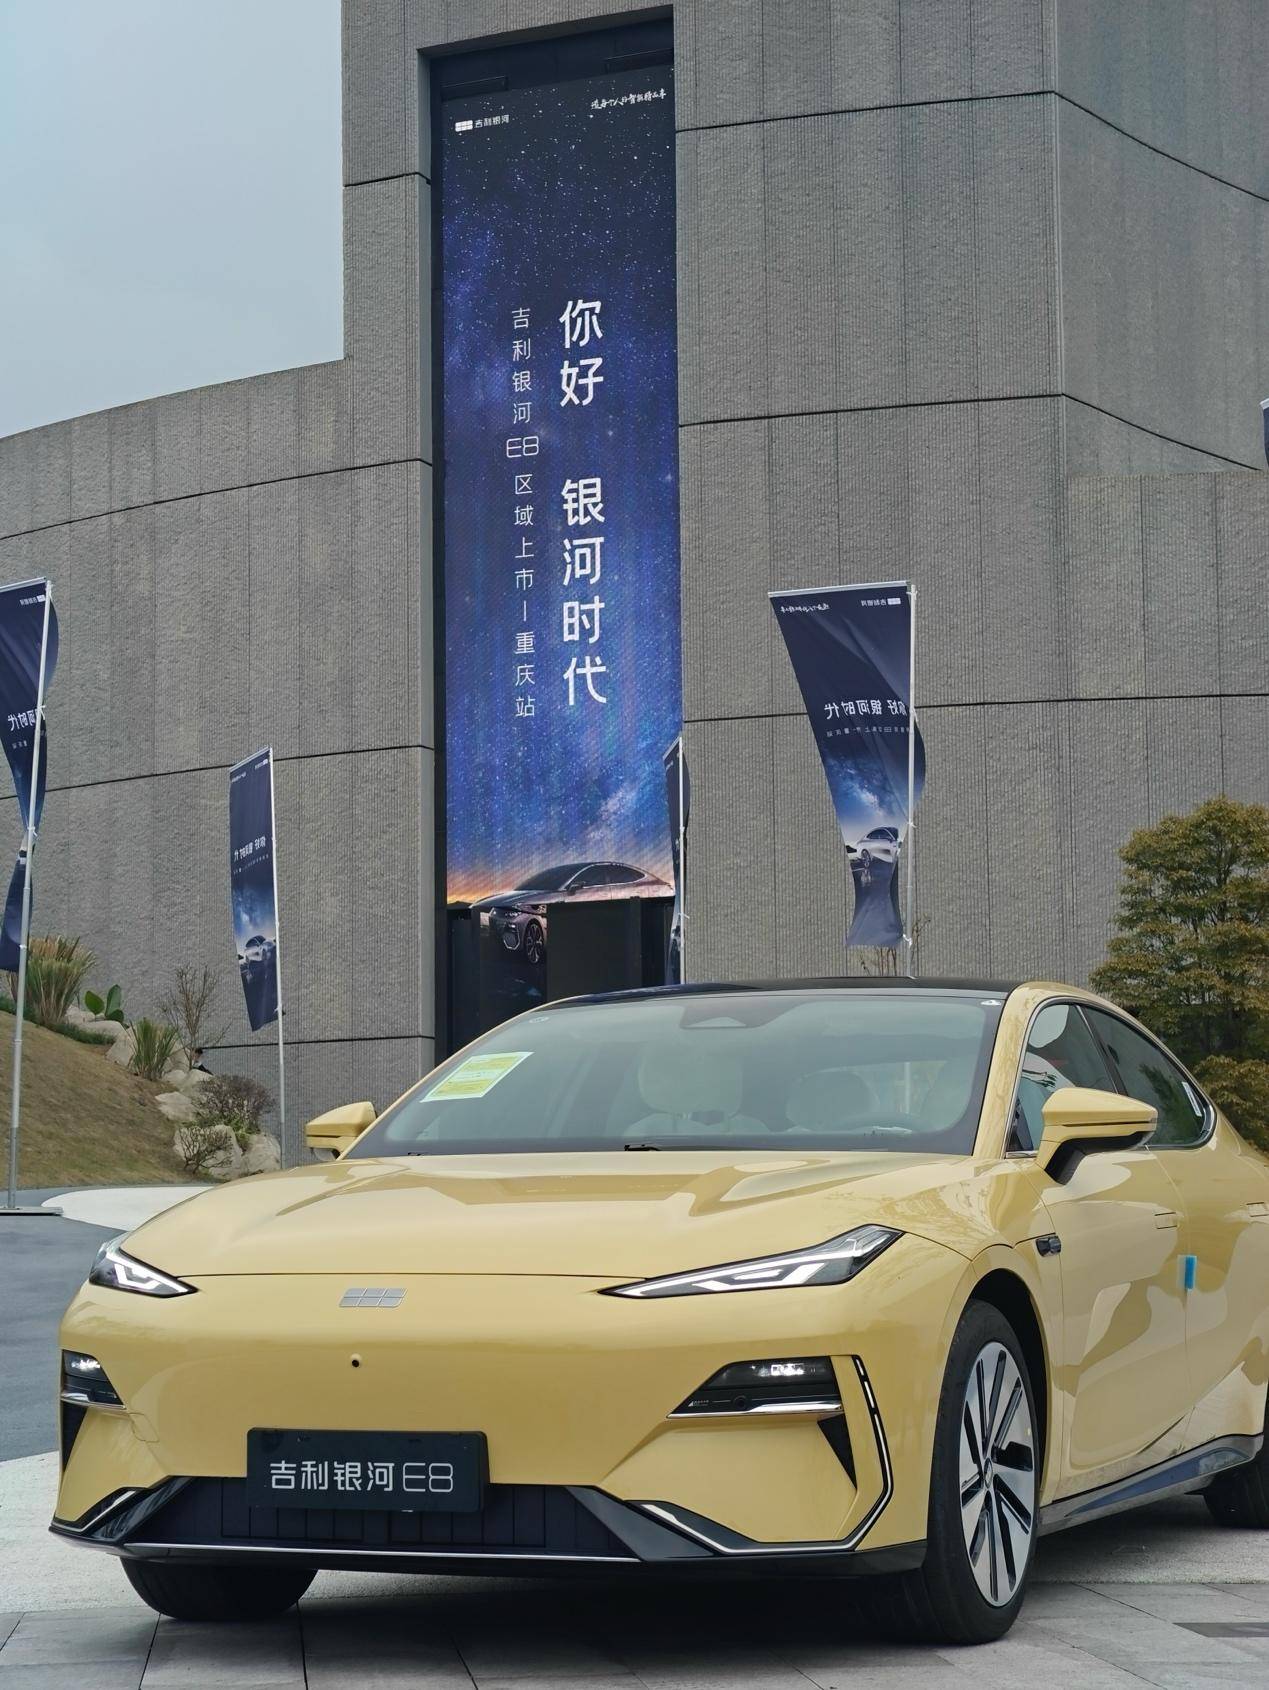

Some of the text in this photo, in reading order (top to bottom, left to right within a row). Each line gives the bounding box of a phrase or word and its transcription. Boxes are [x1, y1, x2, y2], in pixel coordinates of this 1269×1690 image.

[474, 114, 510, 129] 吉利银河
[559, 299, 608, 706] 你好 银河时代
